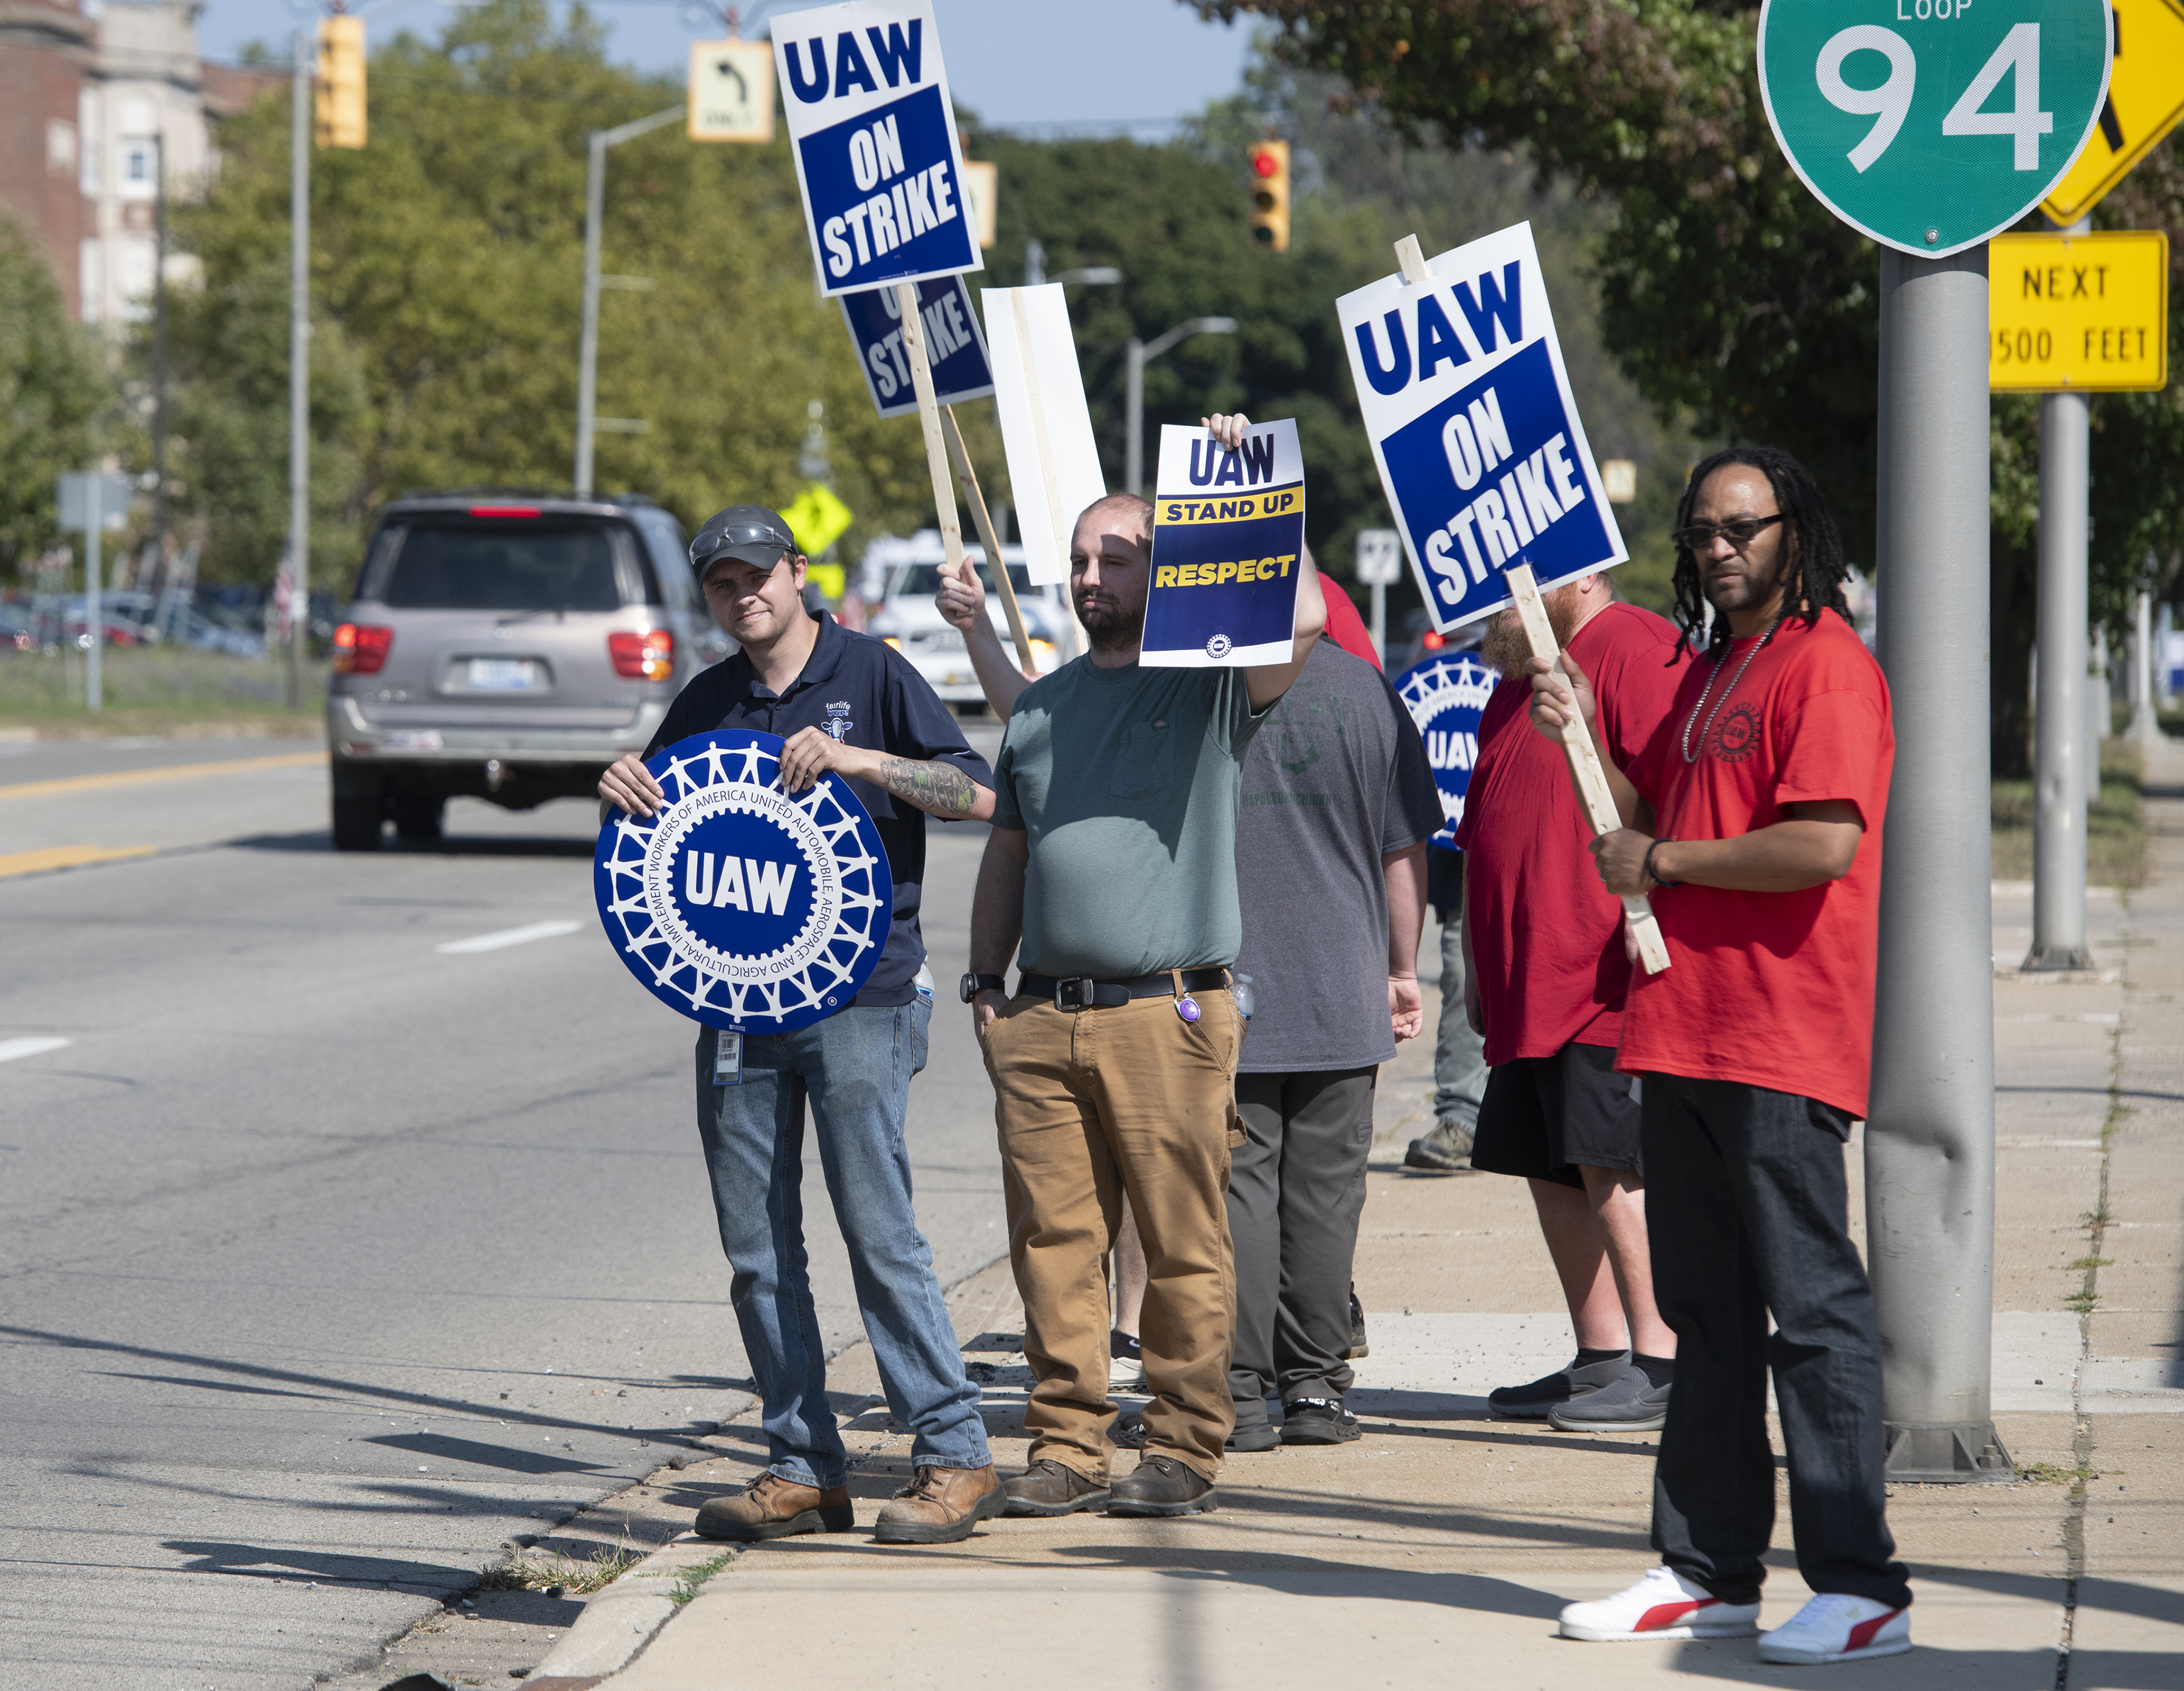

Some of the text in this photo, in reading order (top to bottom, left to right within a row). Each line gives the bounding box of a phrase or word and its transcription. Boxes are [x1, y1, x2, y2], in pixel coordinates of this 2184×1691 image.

[1897, 0, 1972, 20] LOOP
[784, 18, 922, 104] UAW
[1815, 23, 2054, 174] 94
[849, 113, 906, 191] ON
[823, 160, 957, 278] STRIKE
[2022, 266, 2109, 298] NEXT
[869, 290, 972, 398] STIKE
[1354, 259, 1524, 396] UAW
[2084, 327, 2147, 362] FEET
[1189, 433, 1274, 486] UAW
[1442, 386, 1513, 491] ON
[1166, 493, 1294, 521] STAND UP
[1425, 432, 1586, 605] STRIKE
[1155, 554, 1296, 588] RESPECT
[825, 701, 851, 710] fairlife
[678, 803, 693, 820] OF
[696, 790, 747, 810] AMERICA
[750, 792, 793, 819] UNITED
[650, 817, 680, 871] WORKERS
[791, 817, 833, 895] AUTOMOBILE,
[649, 874, 683, 944] IMPLEMENT
[686, 850, 798, 916] UAW
[794, 898, 833, 961] AEROSPACE
[683, 940, 767, 978] AGRICULTURAL
[770, 954, 795, 973] AND
